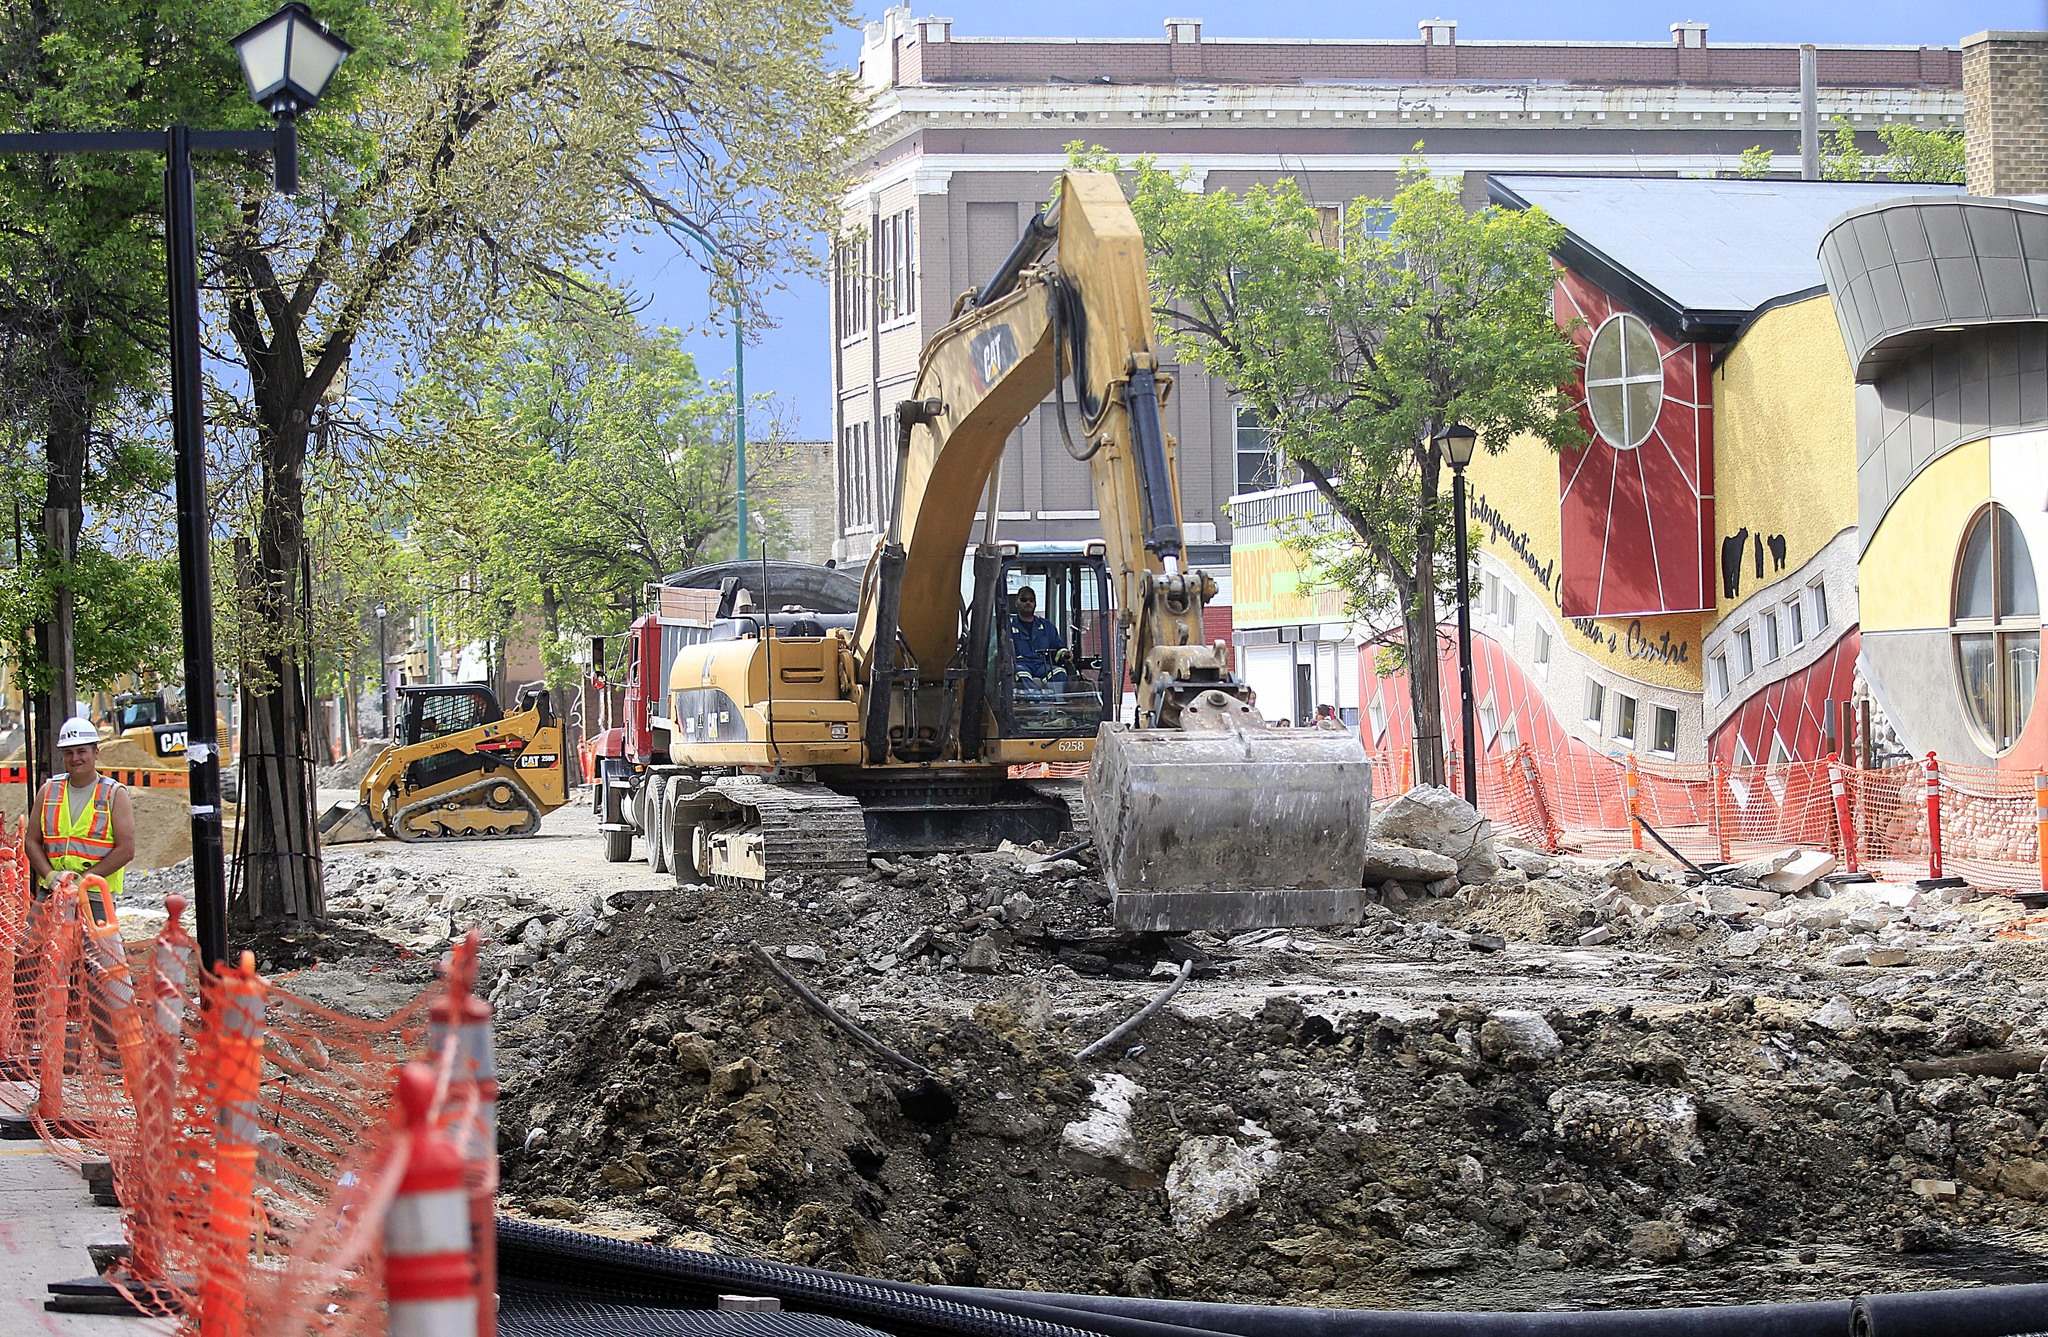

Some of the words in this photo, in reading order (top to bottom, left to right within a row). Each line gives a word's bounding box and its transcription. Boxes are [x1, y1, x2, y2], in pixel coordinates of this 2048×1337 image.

[983, 333, 1002, 384] CAT
[1468, 484, 1551, 592] Intergenerational
[1625, 619, 1689, 665] Centre
[160, 731, 188, 753] CAT
[1058, 741, 1085, 752] 6258
[521, 756, 540, 768] CAT
